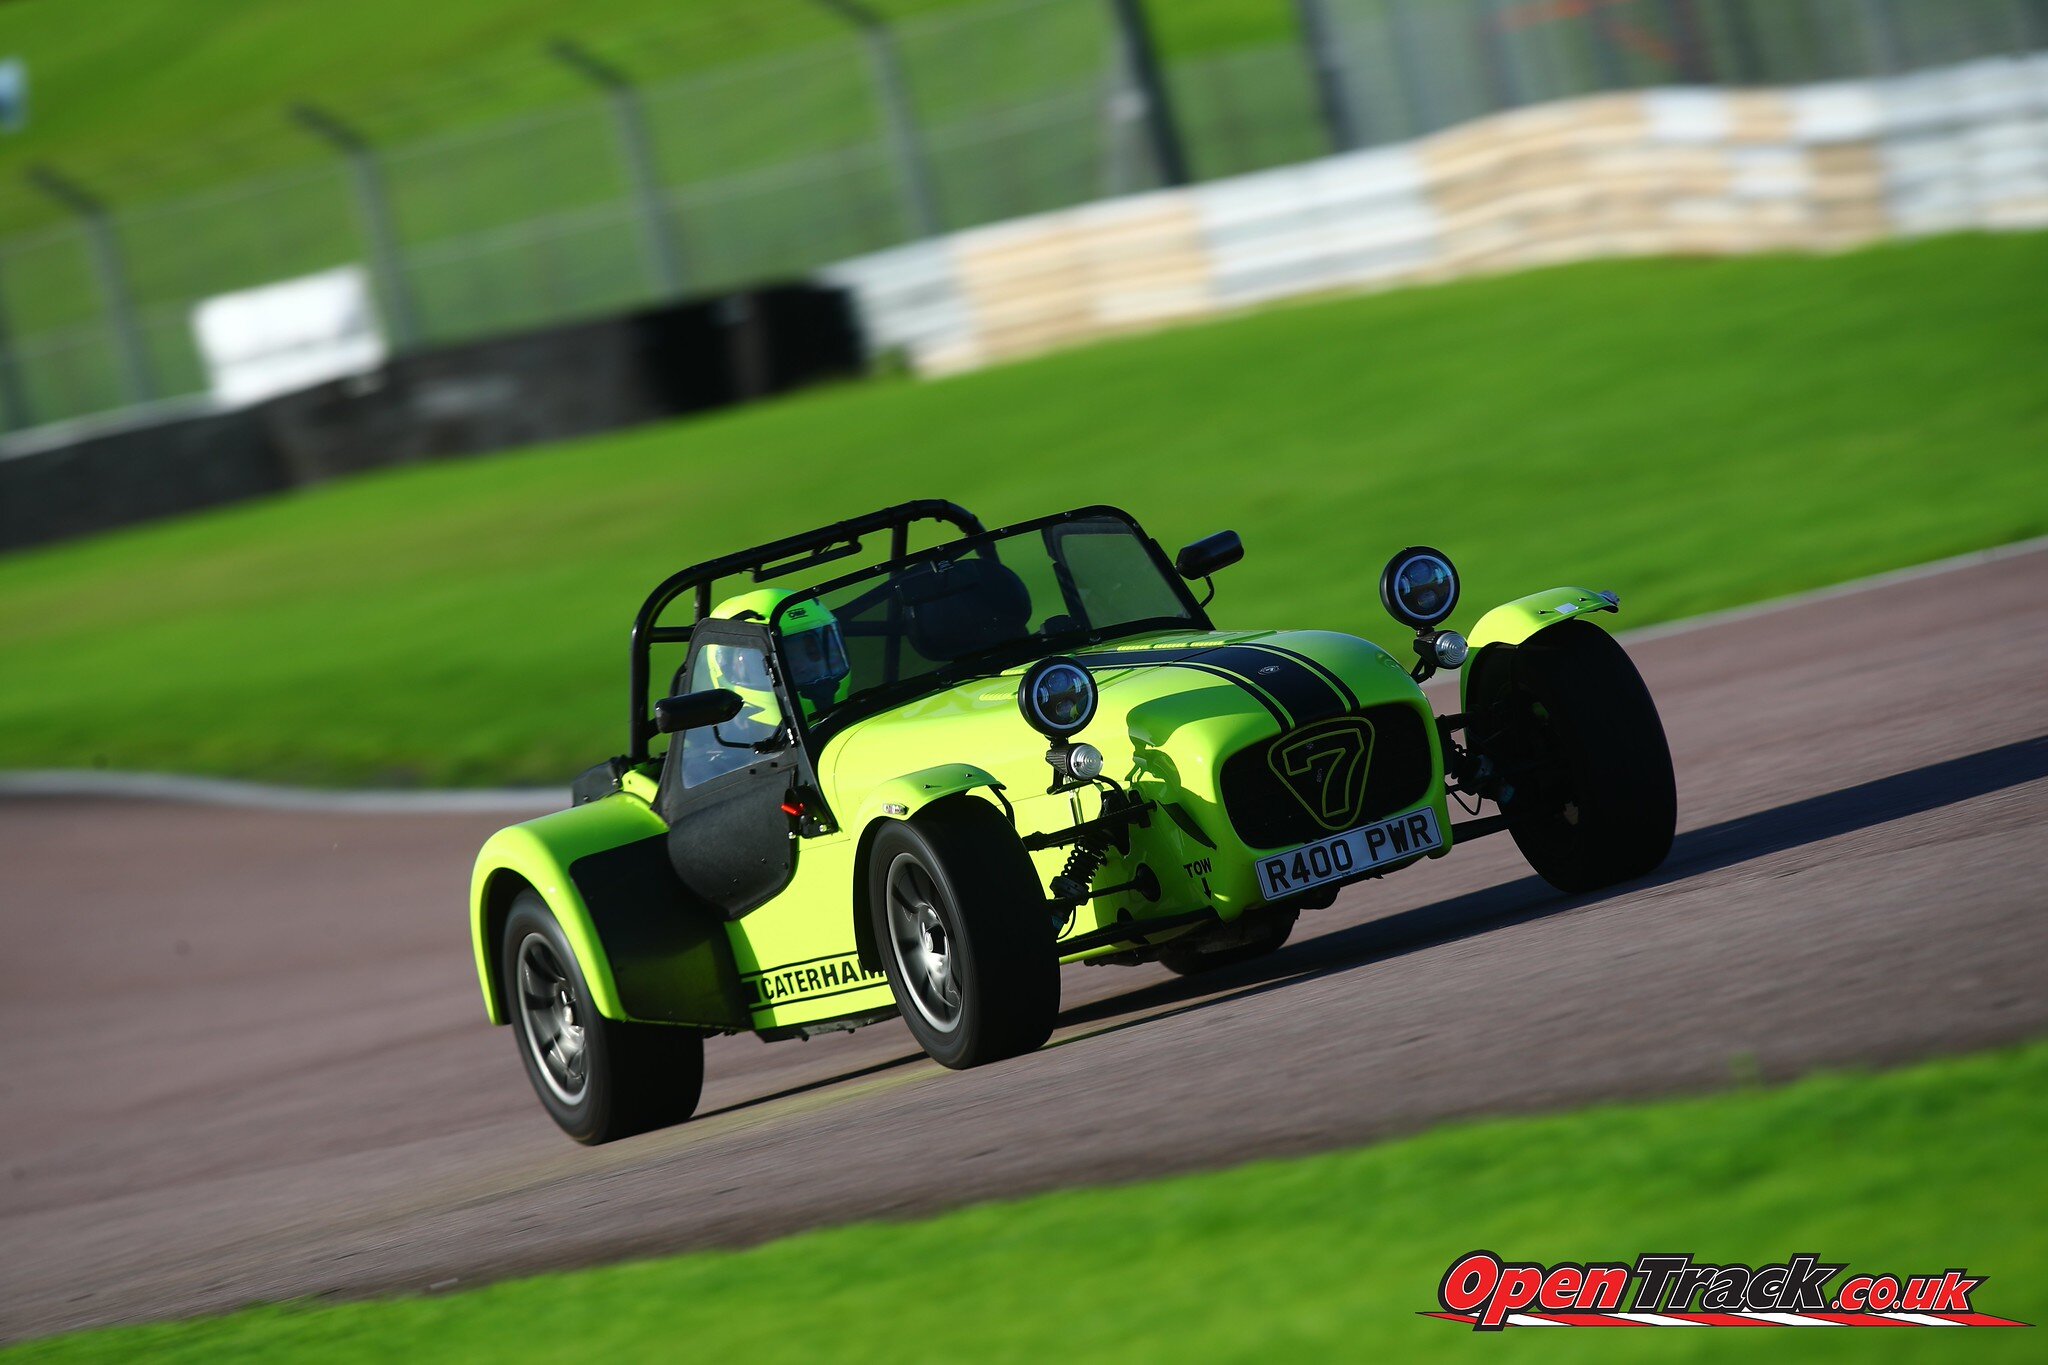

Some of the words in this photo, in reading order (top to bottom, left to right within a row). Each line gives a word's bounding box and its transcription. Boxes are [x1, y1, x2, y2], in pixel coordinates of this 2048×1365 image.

[1282, 727, 1365, 818] 7
[1183, 857, 1213, 878] TOW
[1265, 839, 1353, 892] R400
[1365, 814, 1433, 861] PWR
